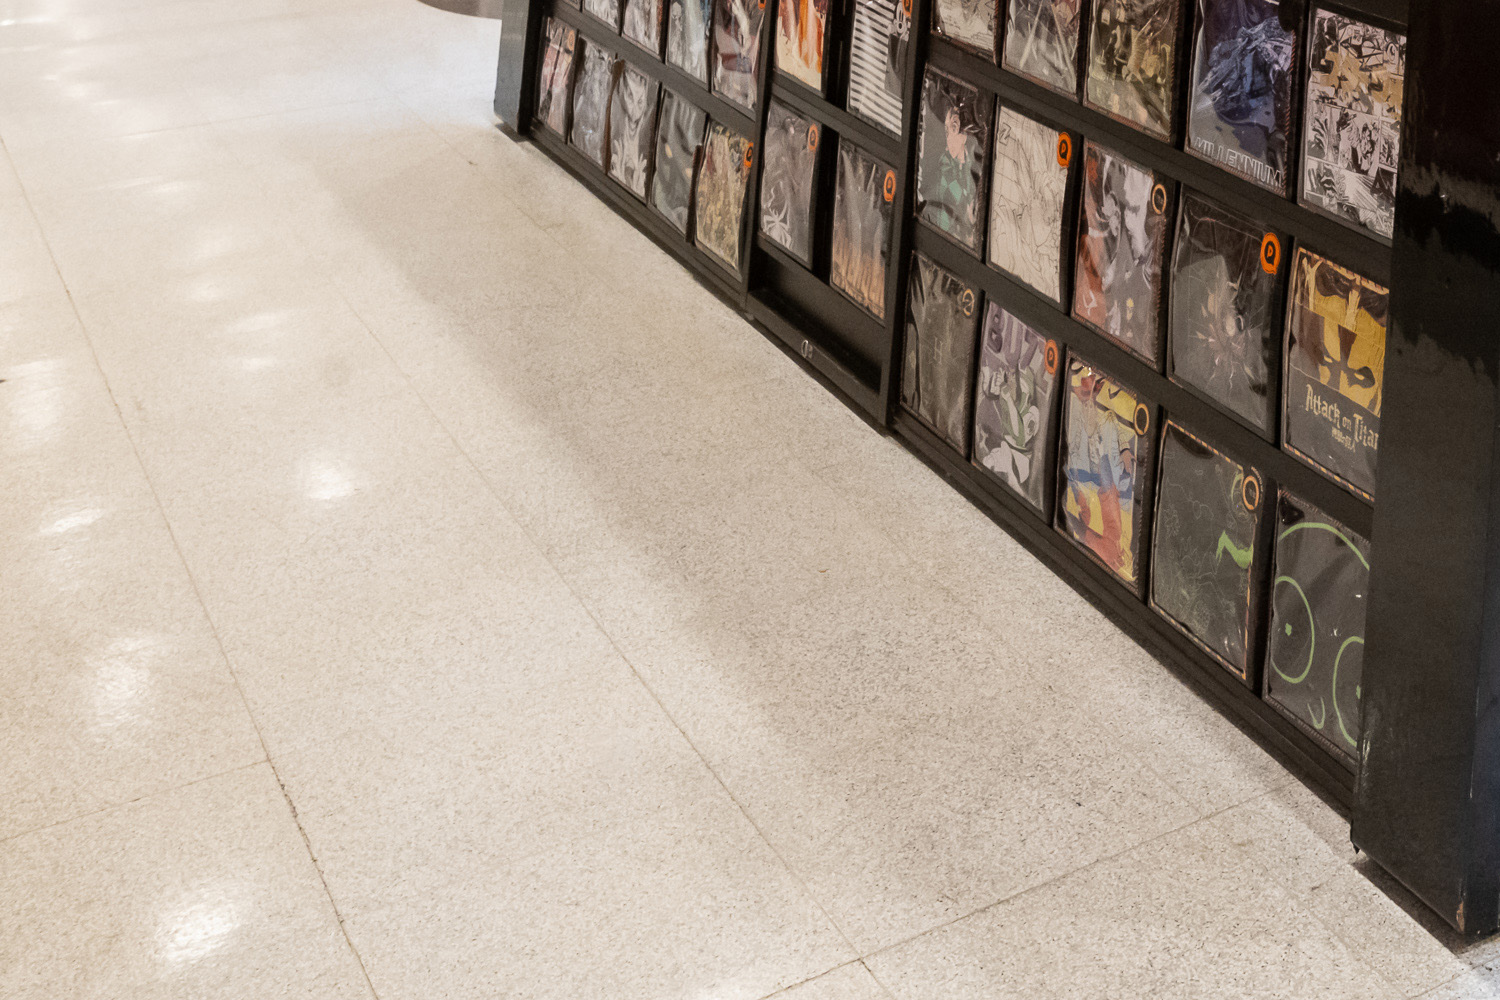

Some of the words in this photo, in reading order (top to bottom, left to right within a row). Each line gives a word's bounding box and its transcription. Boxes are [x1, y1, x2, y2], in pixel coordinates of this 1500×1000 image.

[1195, 137, 1285, 188] MILLENNIUM
[1305, 383, 1341, 429] Attack
[1342, 416, 1352, 431] on
